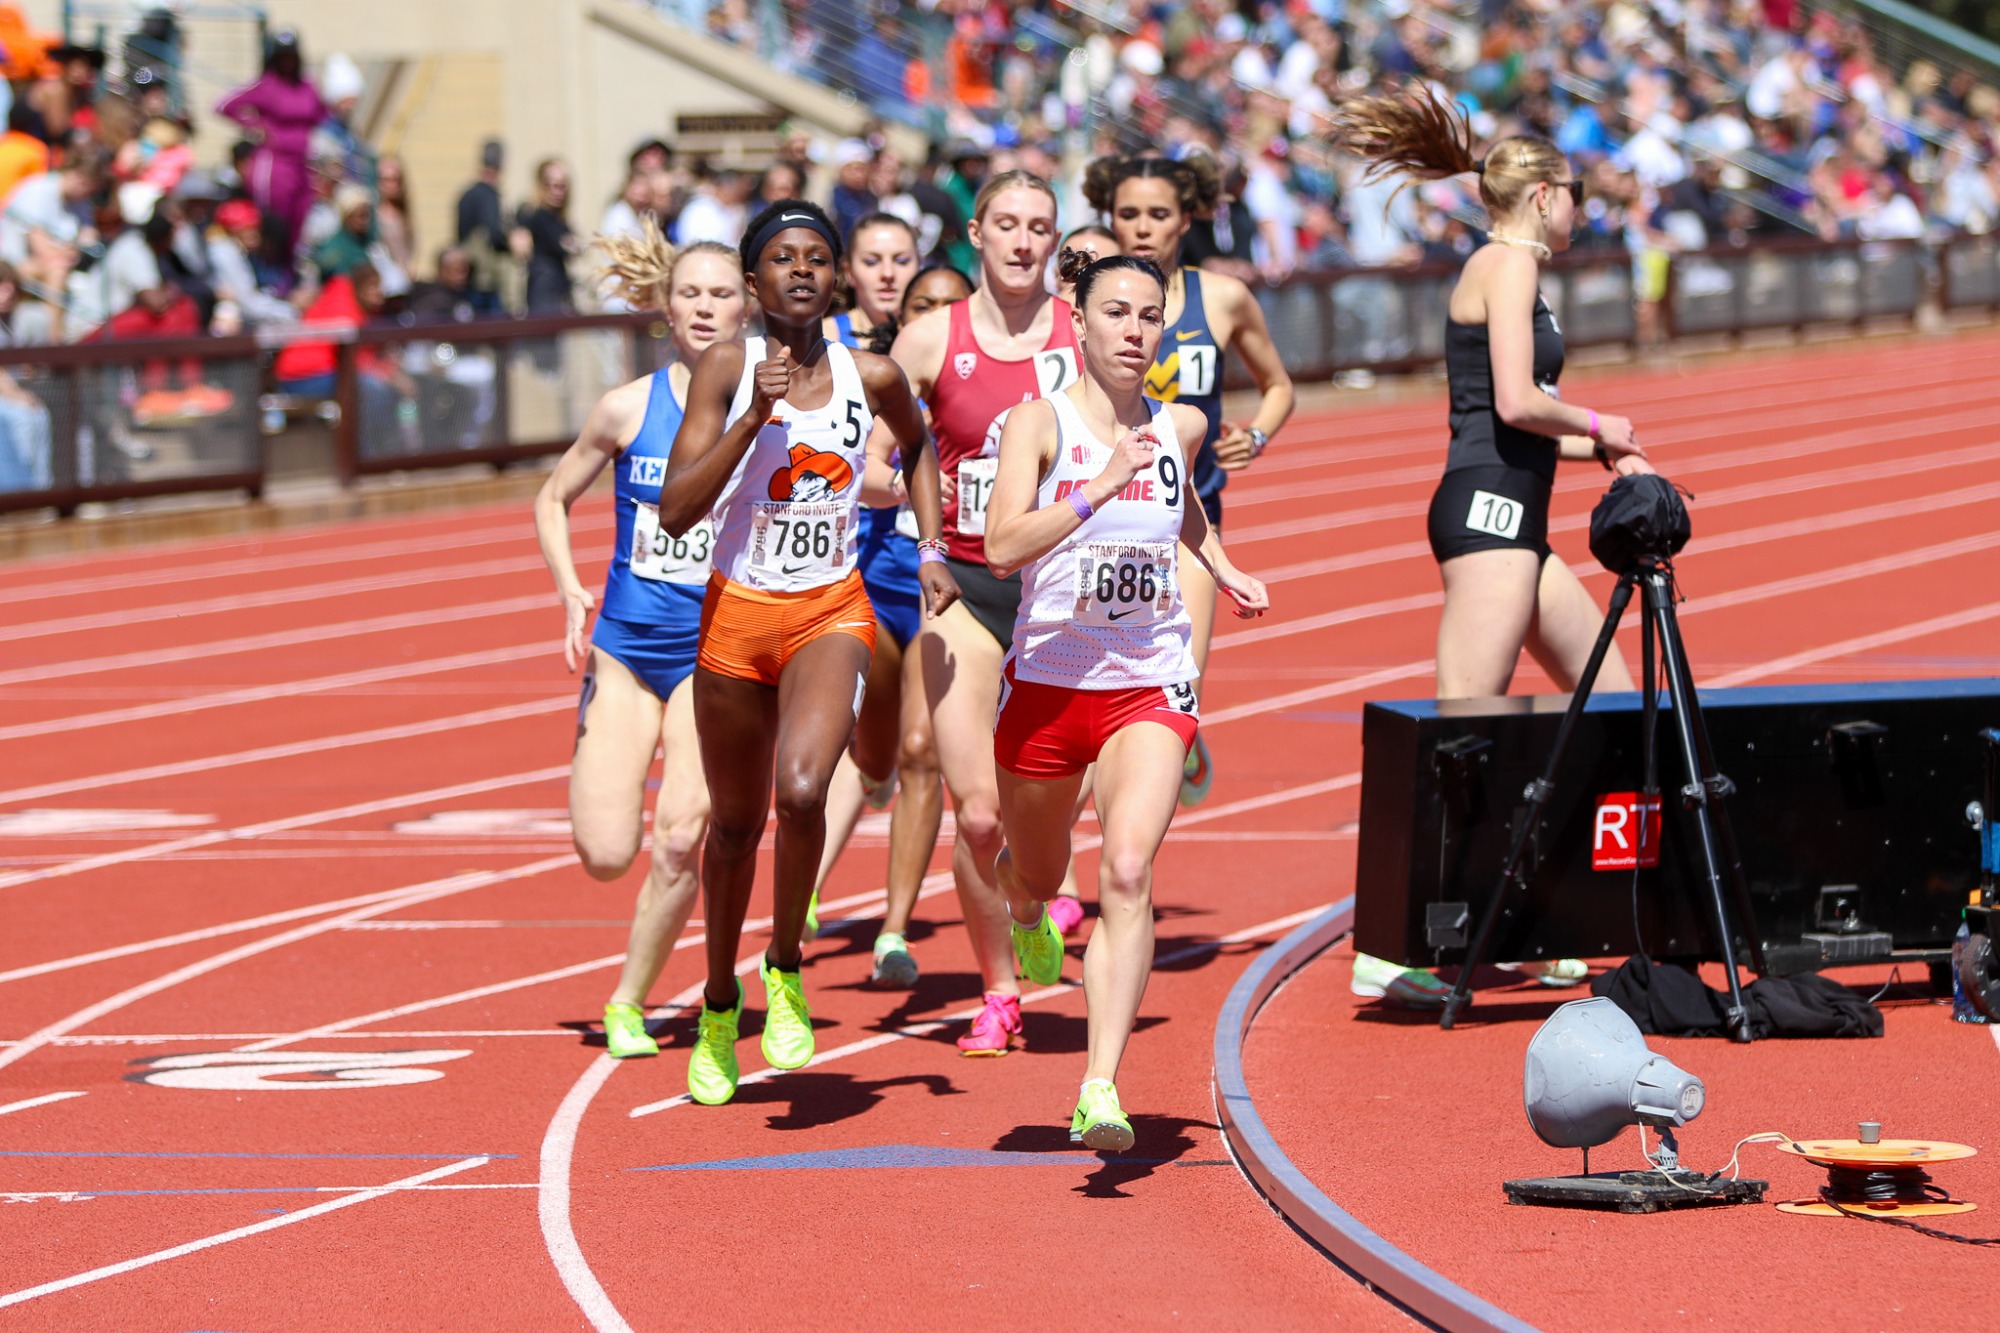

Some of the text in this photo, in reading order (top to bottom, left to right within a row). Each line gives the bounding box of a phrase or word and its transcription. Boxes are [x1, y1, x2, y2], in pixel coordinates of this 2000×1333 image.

[1044, 353, 1066, 393] 2
[1191, 351, 1203, 391] 1
[843, 399, 862, 449] 5
[1158, 455, 1180, 507] 9
[763, 502, 840, 517] STANFORD INVITE
[1483, 498, 1514, 533] 10
[653, 522, 710, 562] 563
[773, 519, 831, 559] 786
[1088, 544, 1164, 559] STANFORD INVITE
[1096, 562, 1157, 604] 686
[1594, 803, 1660, 850] RT
